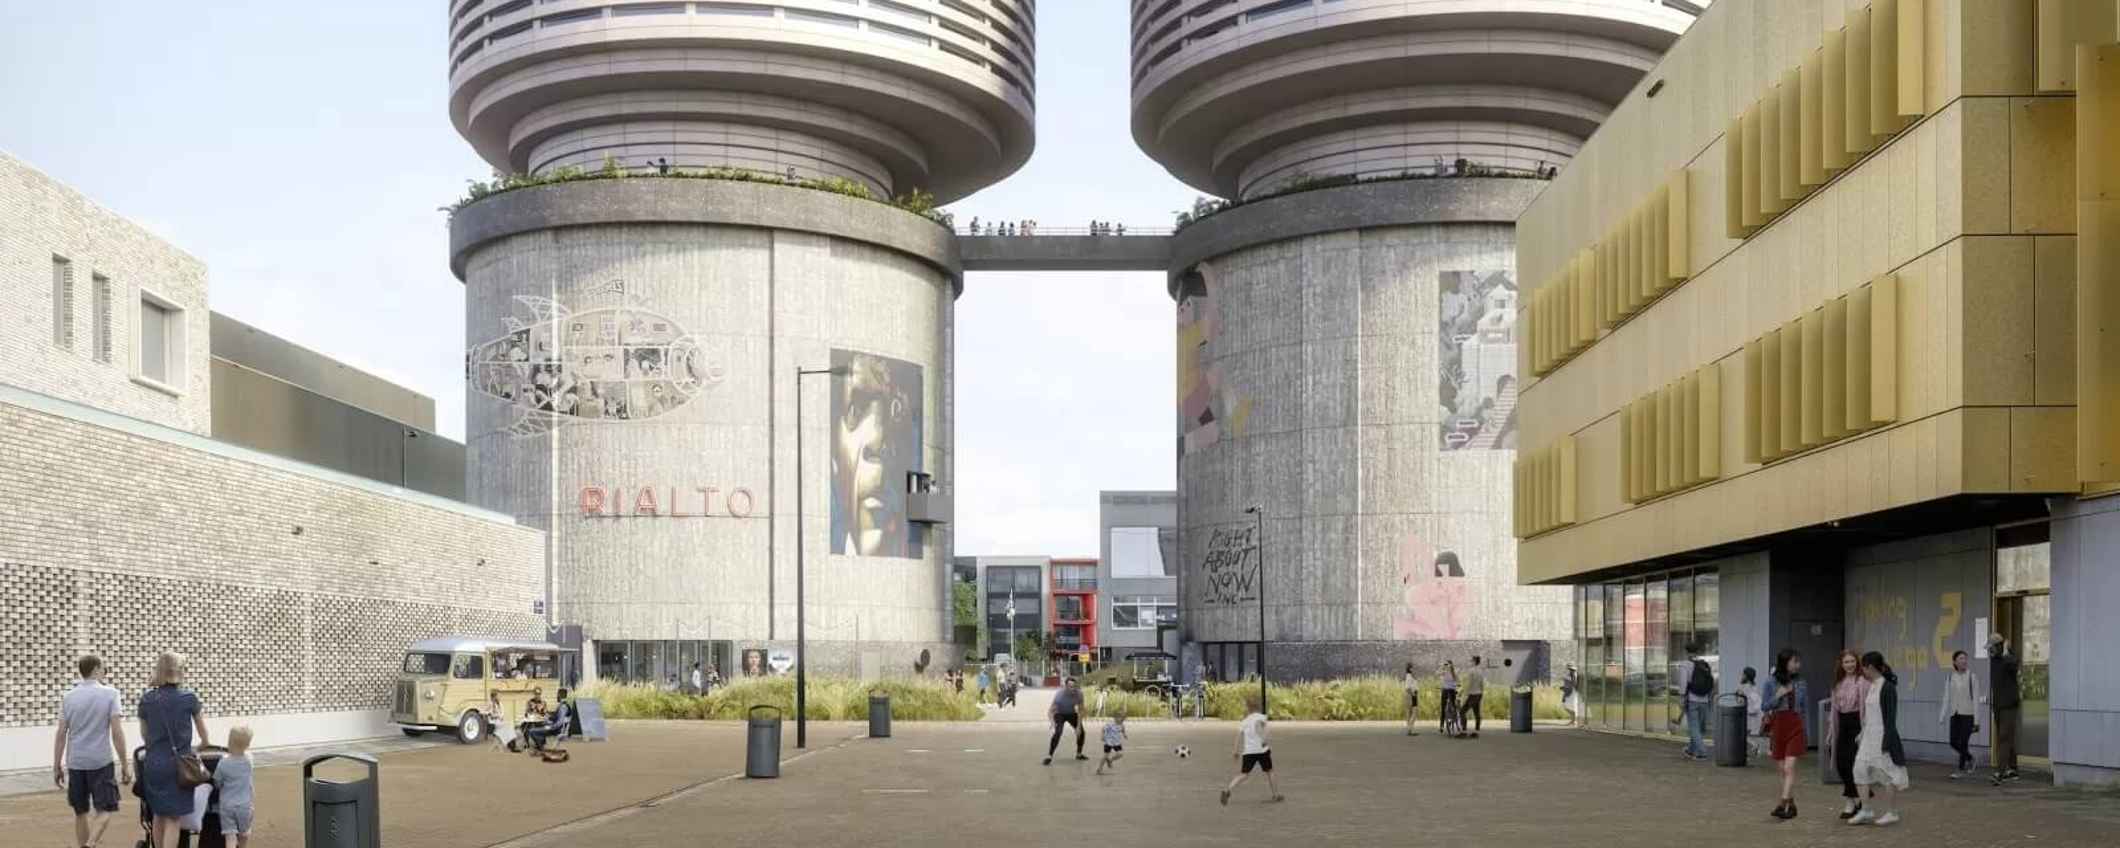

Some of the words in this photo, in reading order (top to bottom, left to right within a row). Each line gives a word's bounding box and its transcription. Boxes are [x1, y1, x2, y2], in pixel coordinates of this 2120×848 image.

[579, 486, 753, 517] RIALTO
[1202, 546, 1257, 573] ABOUT
[1204, 563, 1257, 597] NOW
